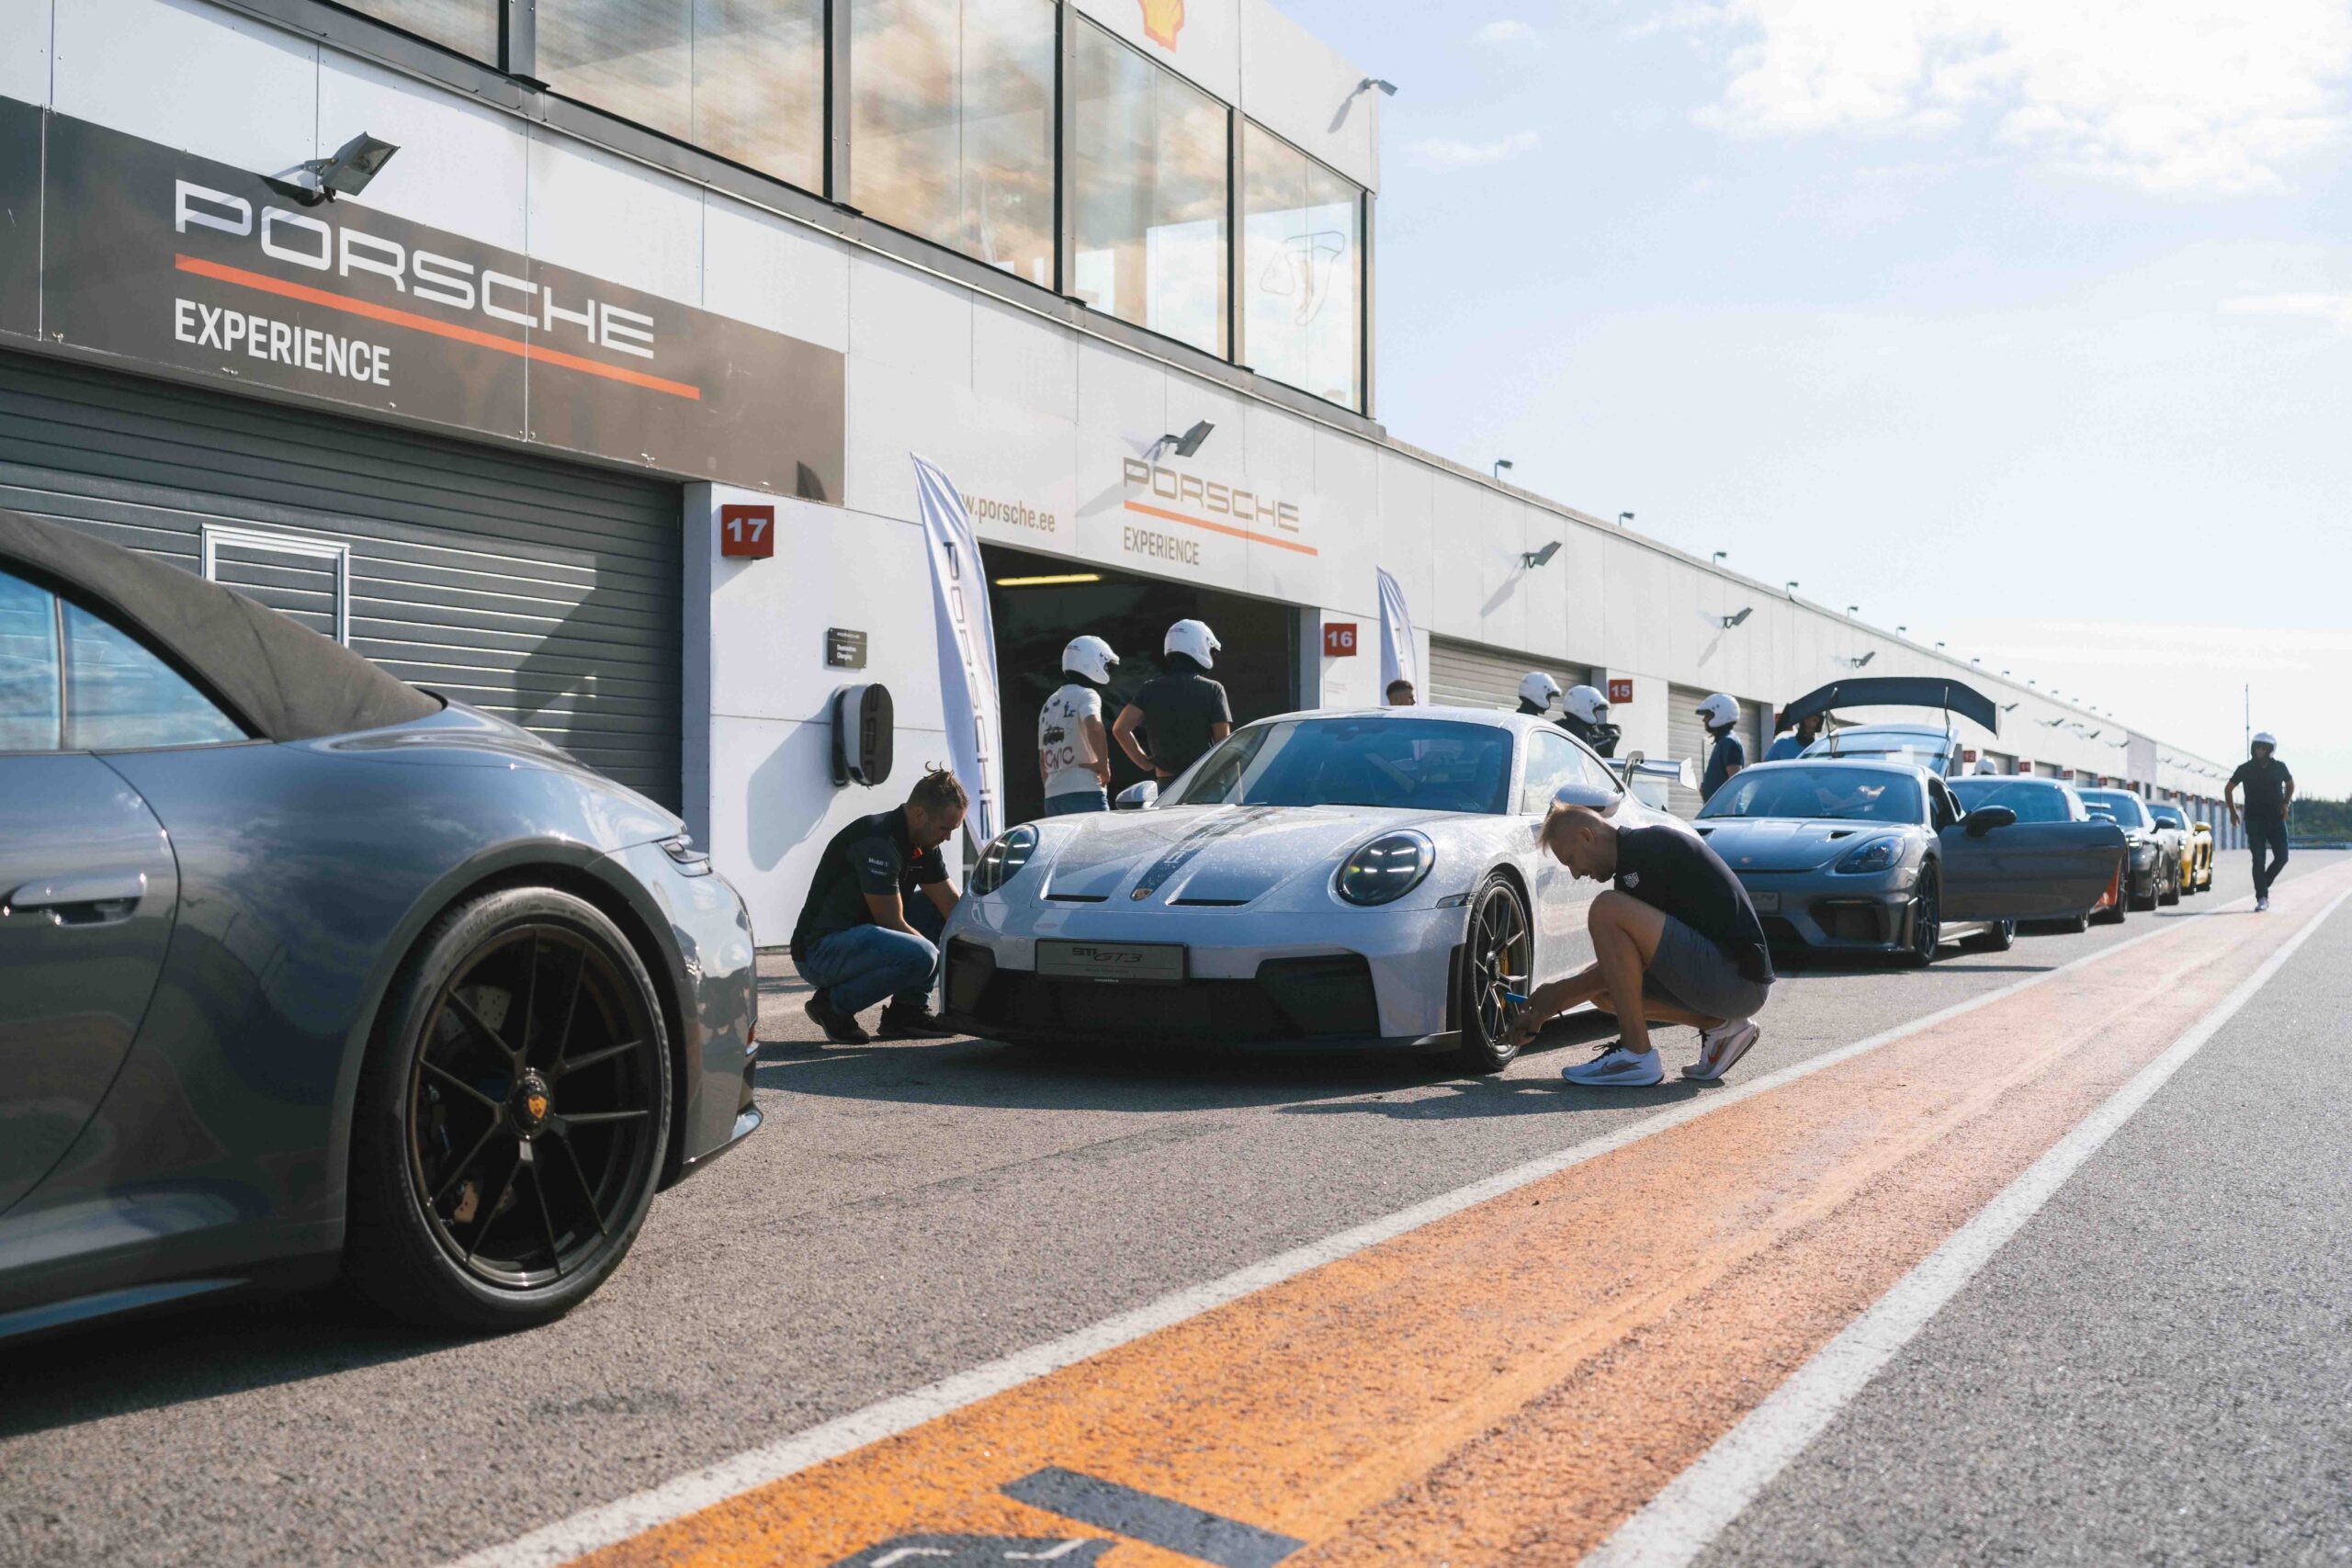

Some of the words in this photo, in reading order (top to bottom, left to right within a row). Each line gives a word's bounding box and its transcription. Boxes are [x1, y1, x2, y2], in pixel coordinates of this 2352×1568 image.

[175, 179, 654, 359] PORSCHE
[175, 298, 391, 388] EXPERIENCE
[961, 493, 1056, 533] w.porsche.ee
[1123, 457, 1300, 534] PORSCHE
[728, 518, 768, 542] 17
[1123, 526, 1200, 566] EXPERIENCE
[1327, 630, 1353, 648] 16
[1611, 684, 1630, 697] 15
[1093, 952, 1143, 964] GT3
